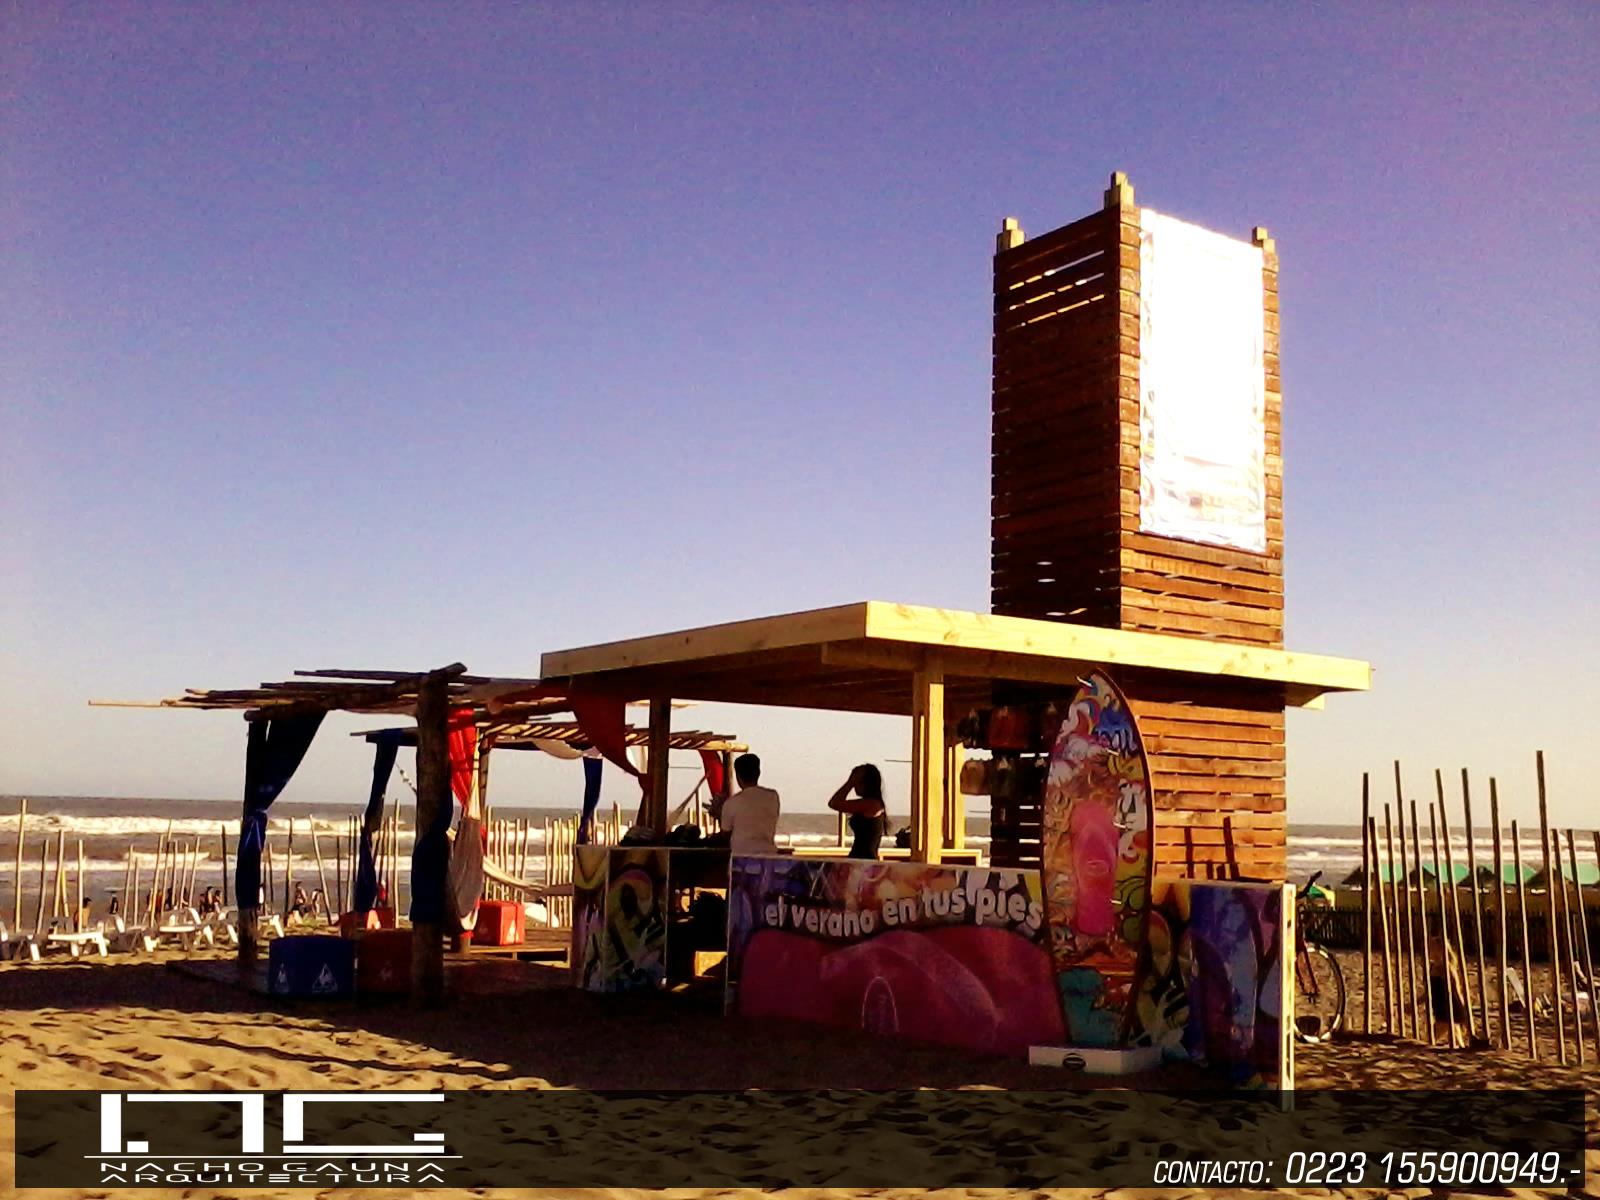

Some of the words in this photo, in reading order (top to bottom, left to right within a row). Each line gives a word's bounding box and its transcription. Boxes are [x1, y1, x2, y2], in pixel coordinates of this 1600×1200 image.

[765, 895, 785, 928] el
[791, 904, 875, 937] verano
[882, 898, 917, 926] en
[921, 886, 967, 919] tus
[975, 888, 1043, 930] pies
